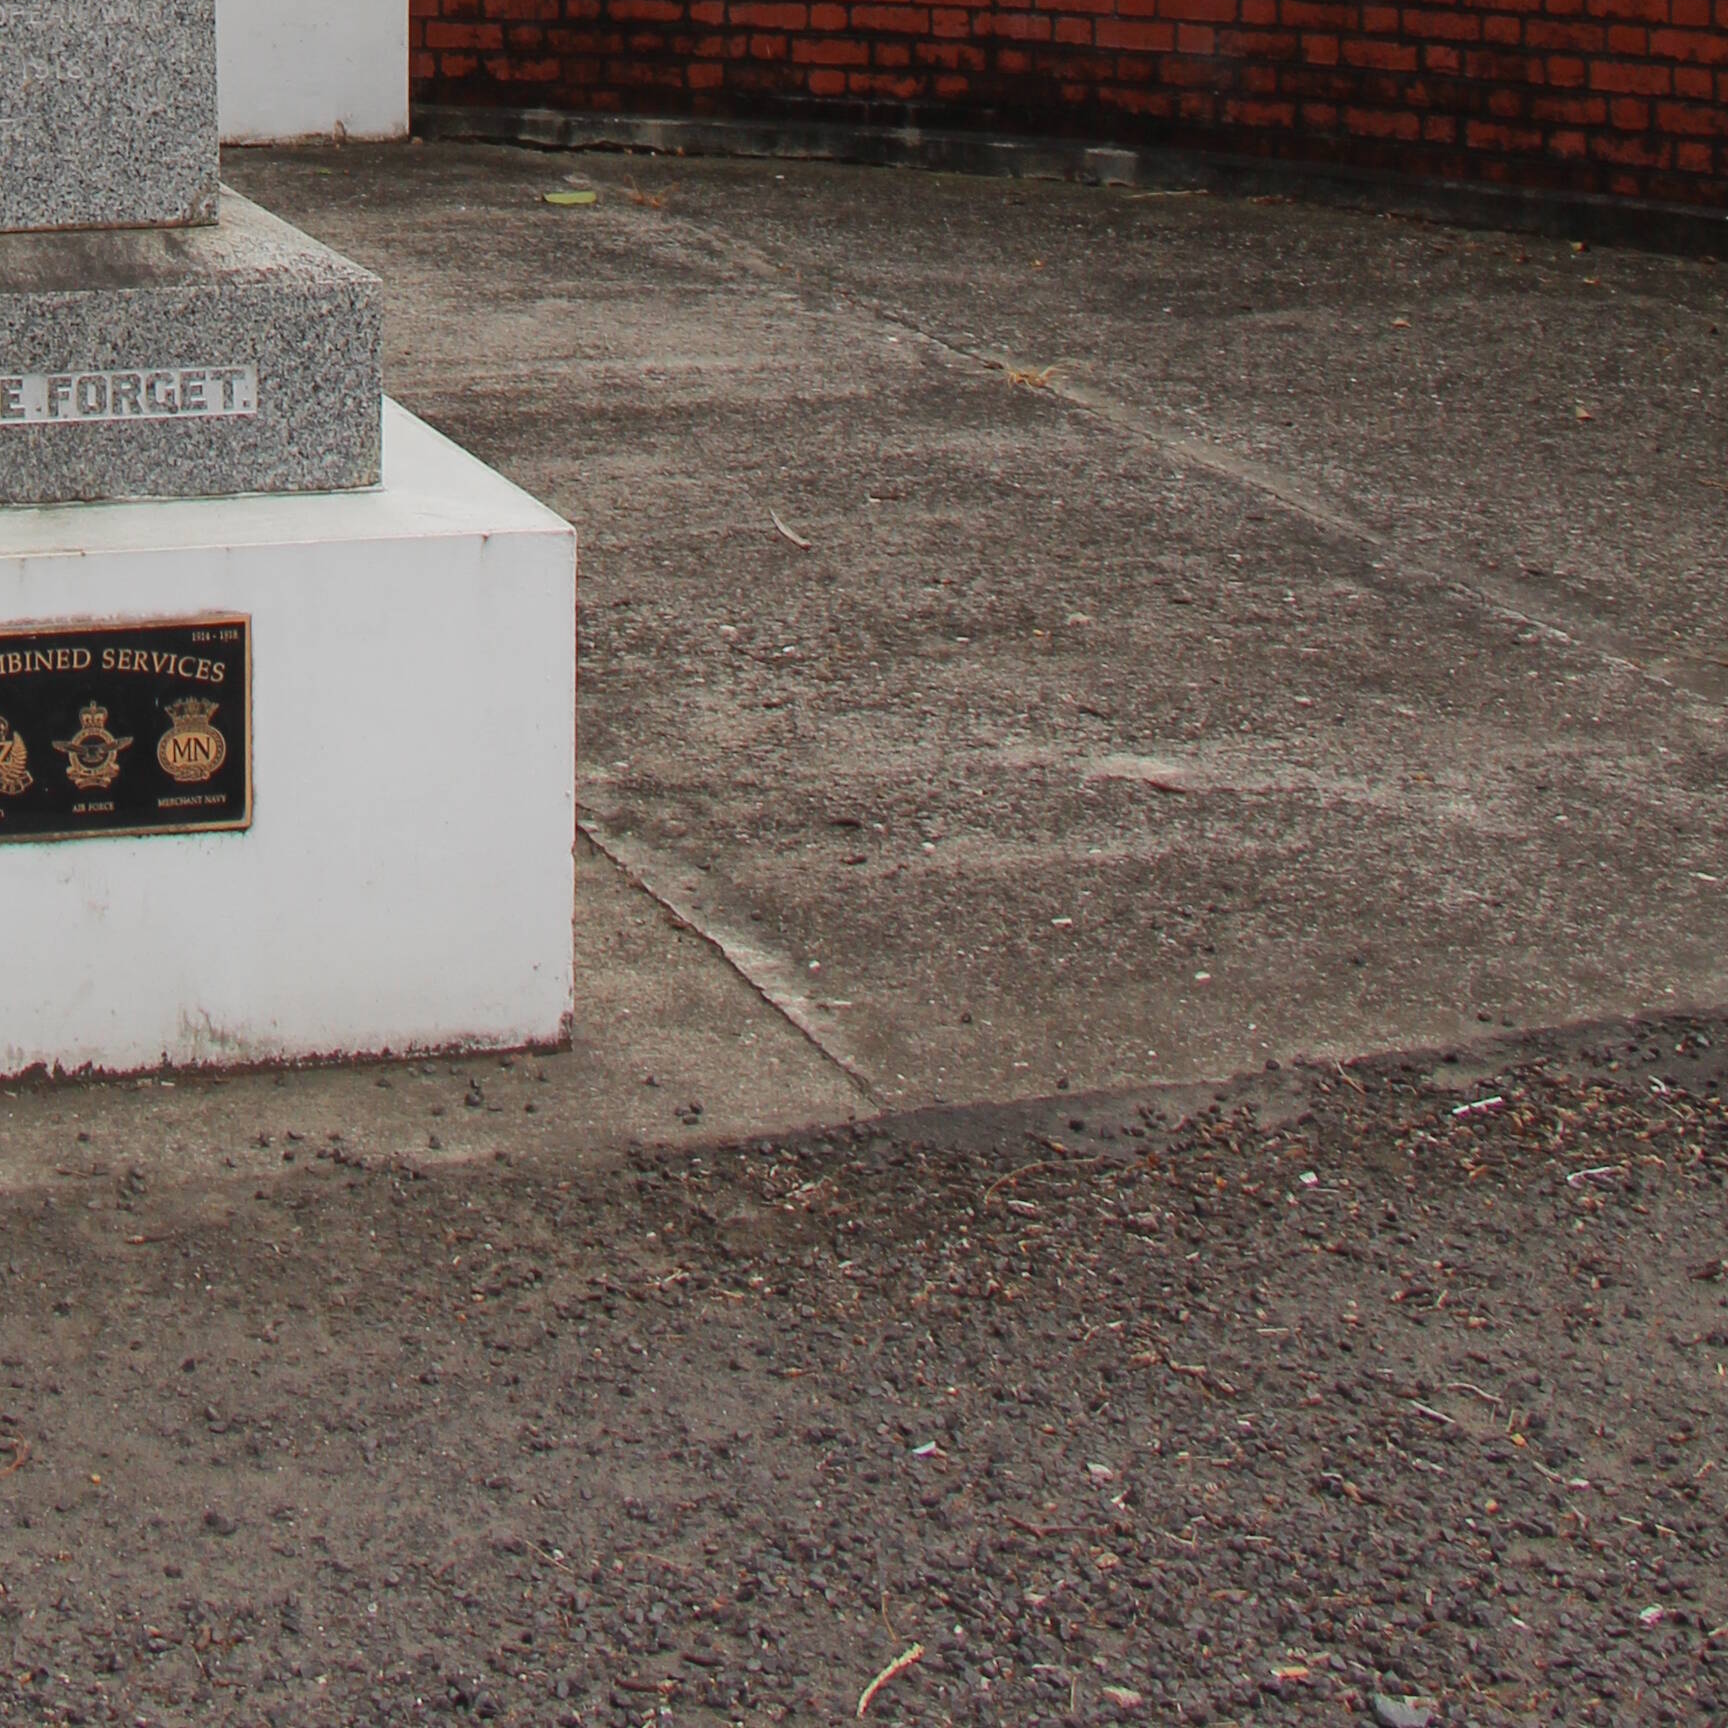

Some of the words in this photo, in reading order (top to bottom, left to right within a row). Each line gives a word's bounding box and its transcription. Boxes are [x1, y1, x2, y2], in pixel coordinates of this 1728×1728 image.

[101, 648, 226, 682] SERVICES
[172, 737, 211, 763] MN
[72, 804, 86, 813] AIR
[88, 801, 114, 812] FORCE
[157, 796, 202, 808] MERCHANT
[204, 794, 227, 804] NAVY
